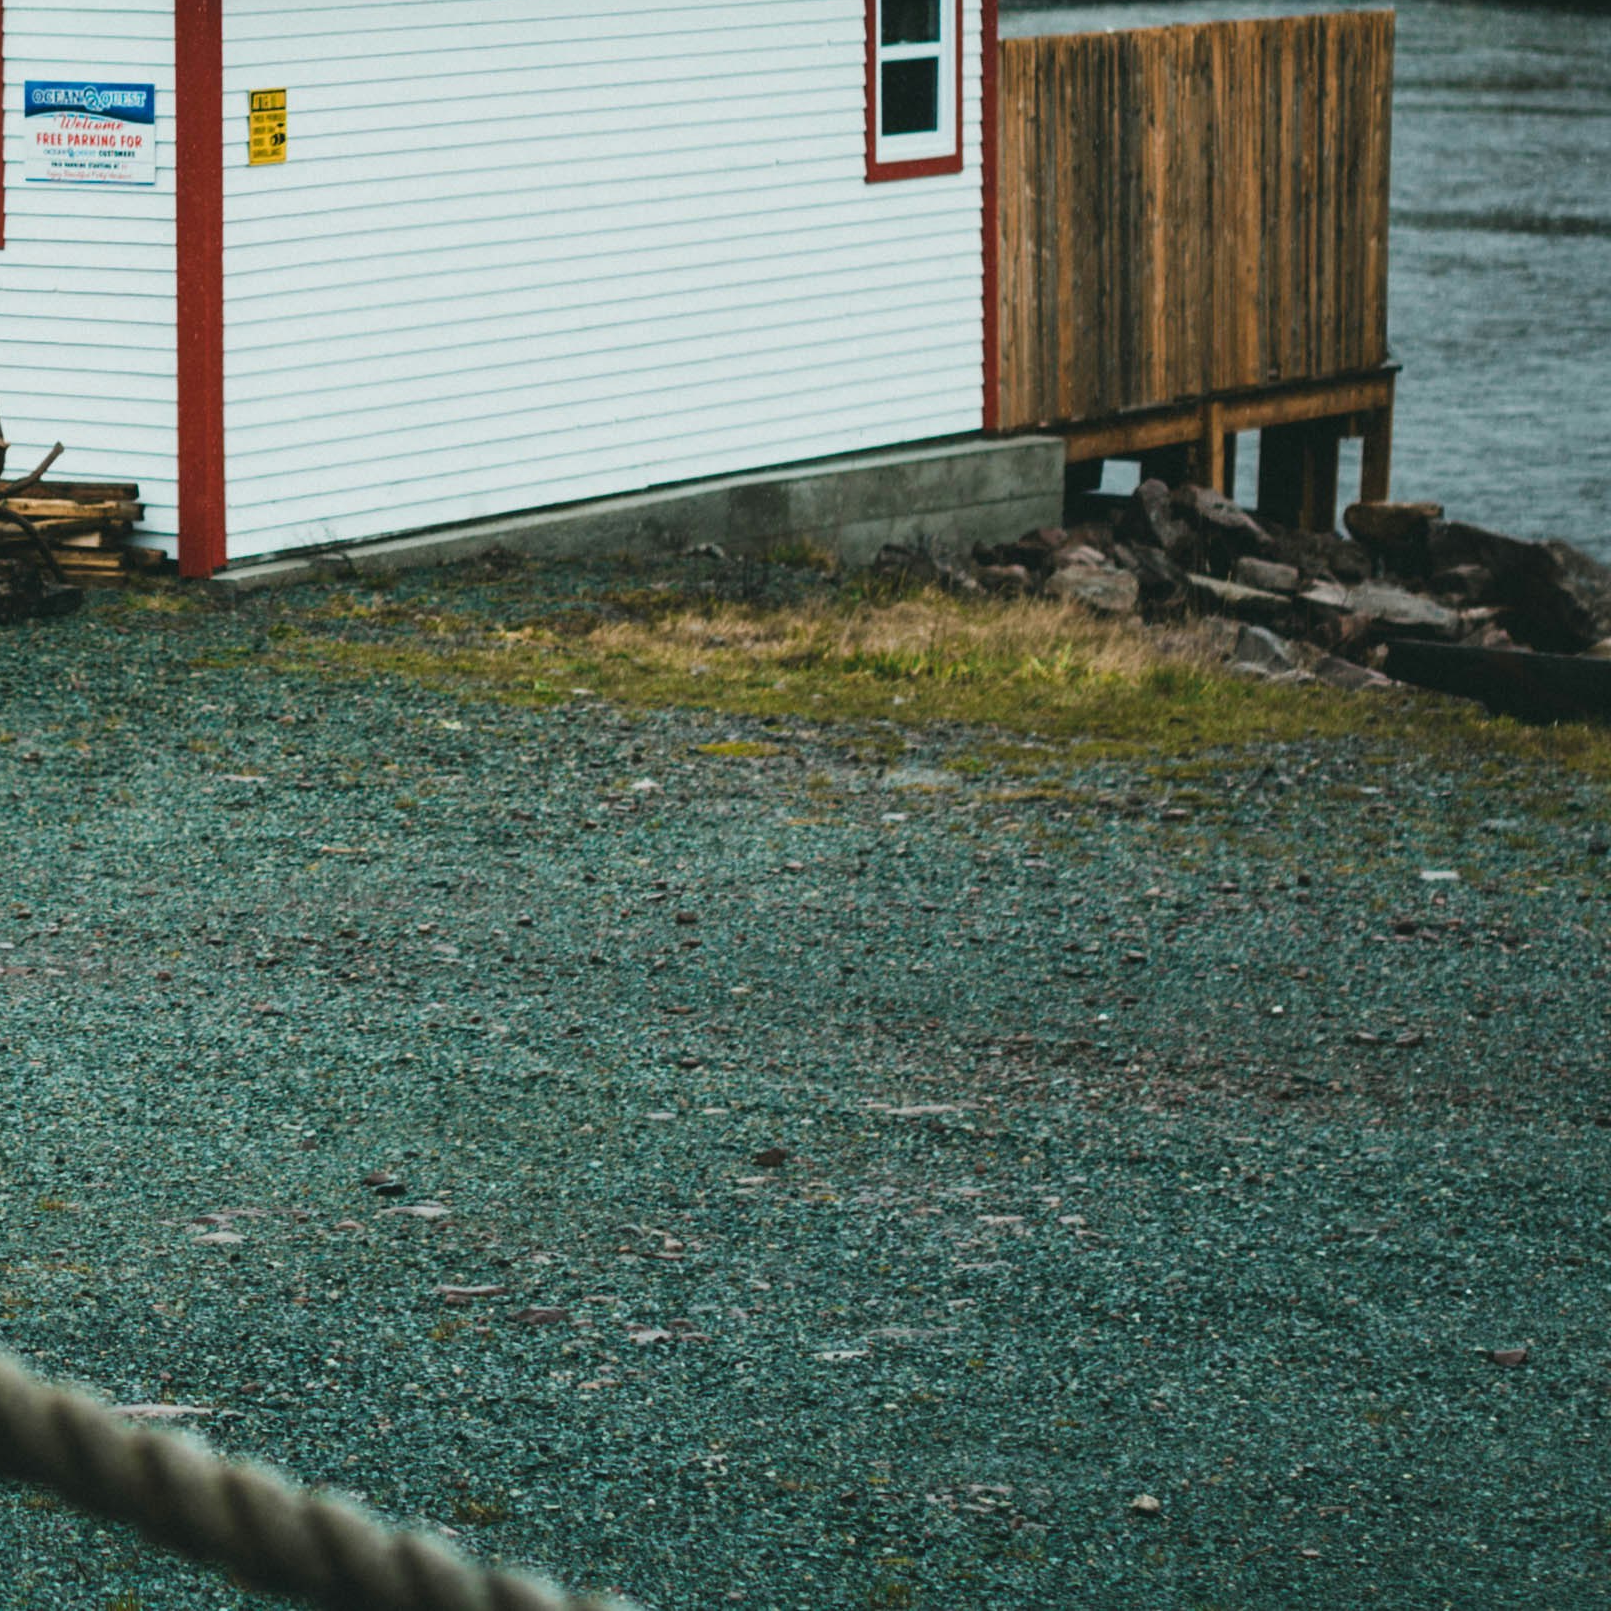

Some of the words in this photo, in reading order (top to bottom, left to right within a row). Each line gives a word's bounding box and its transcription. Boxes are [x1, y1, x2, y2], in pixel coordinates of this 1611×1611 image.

[32, 89, 81, 104] OCEAN
[99, 91, 146, 109] QUEST
[55, 113, 124, 131] Welcome
[36, 132, 62, 146] FREE
[67, 133, 116, 147] PARKING
[121, 135, 143, 148] FOR
